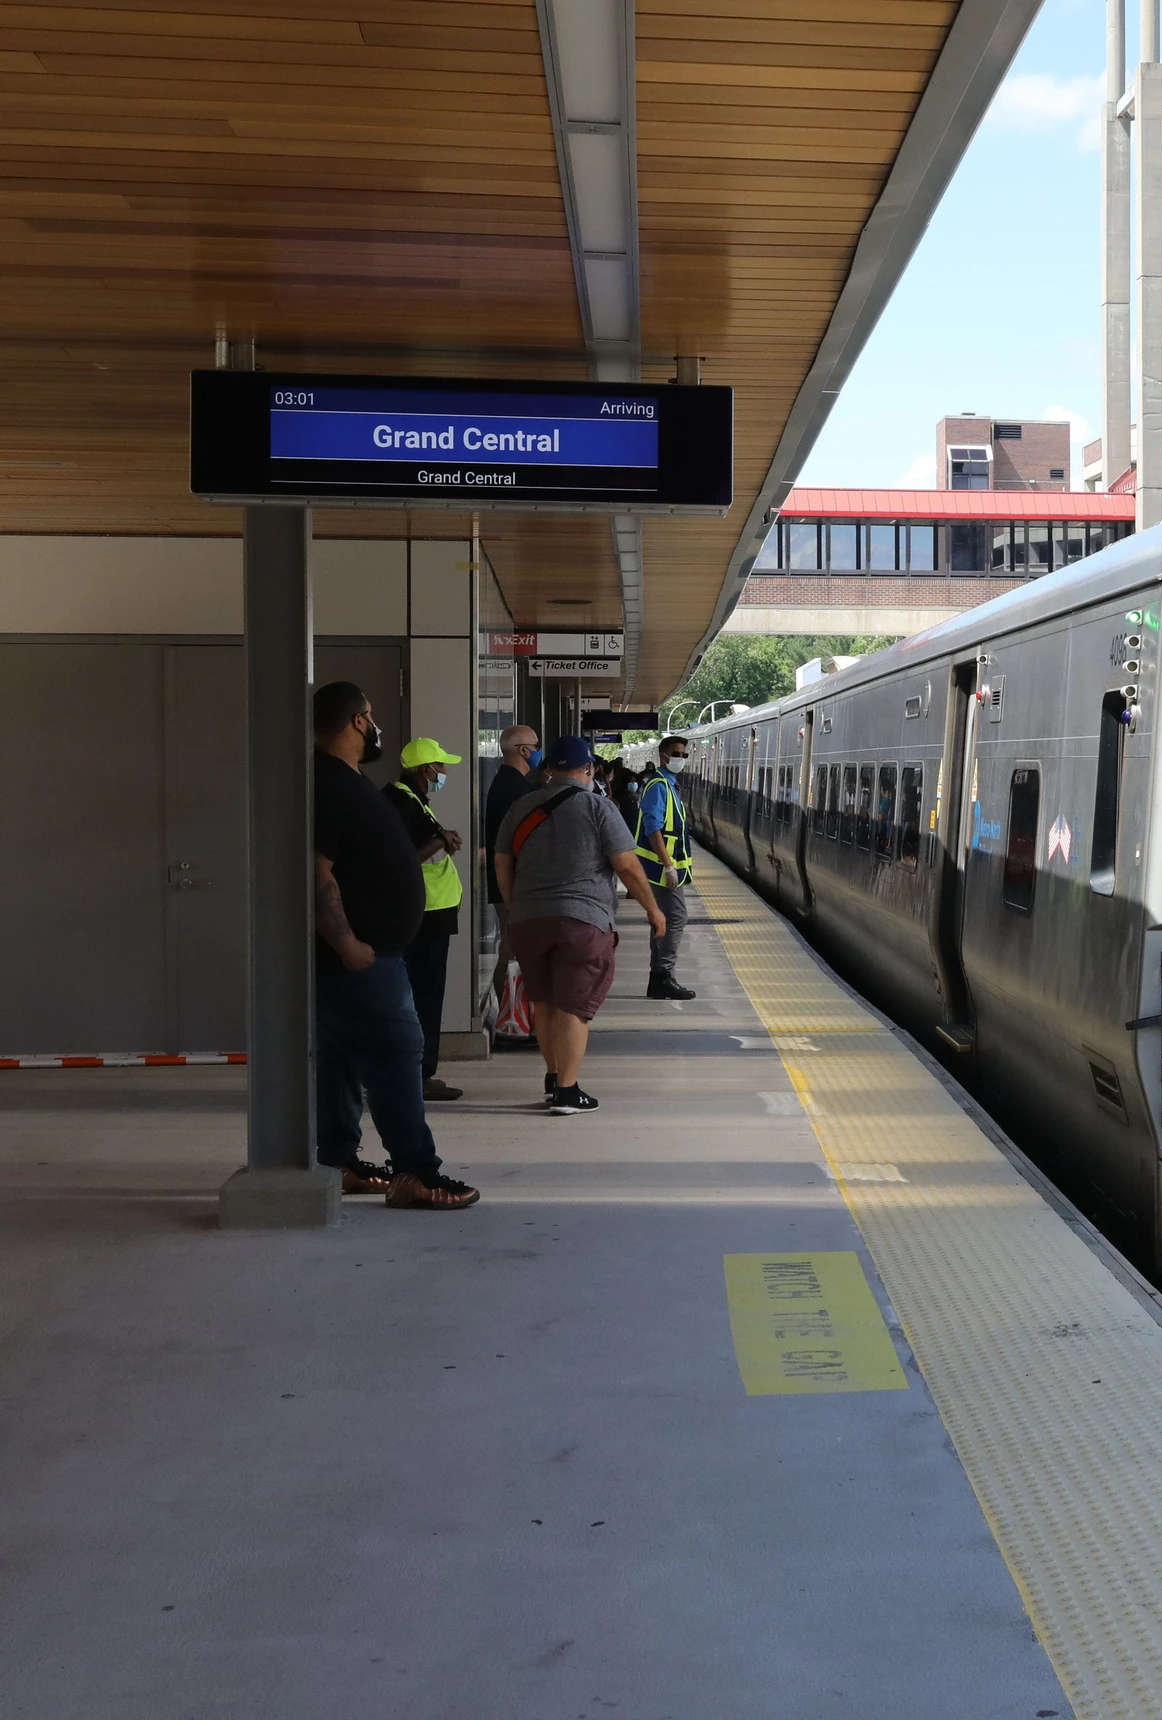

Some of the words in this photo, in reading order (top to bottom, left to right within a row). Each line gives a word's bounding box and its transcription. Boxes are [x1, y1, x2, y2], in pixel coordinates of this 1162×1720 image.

[275, 391, 314, 406] 03:01
[600, 401, 655, 418] Arriving
[373, 424, 455, 450] Grand
[463, 427, 560, 452] Central
[417, 470, 460, 484] Grand
[465, 472, 516, 485] Central
[512, 633, 536, 646] Exit
[545, 660, 577, 670] Ticket
[578, 661, 609, 670] Office
[761, 1261, 823, 1299] WATCH
[772, 1309, 834, 1339] THE
